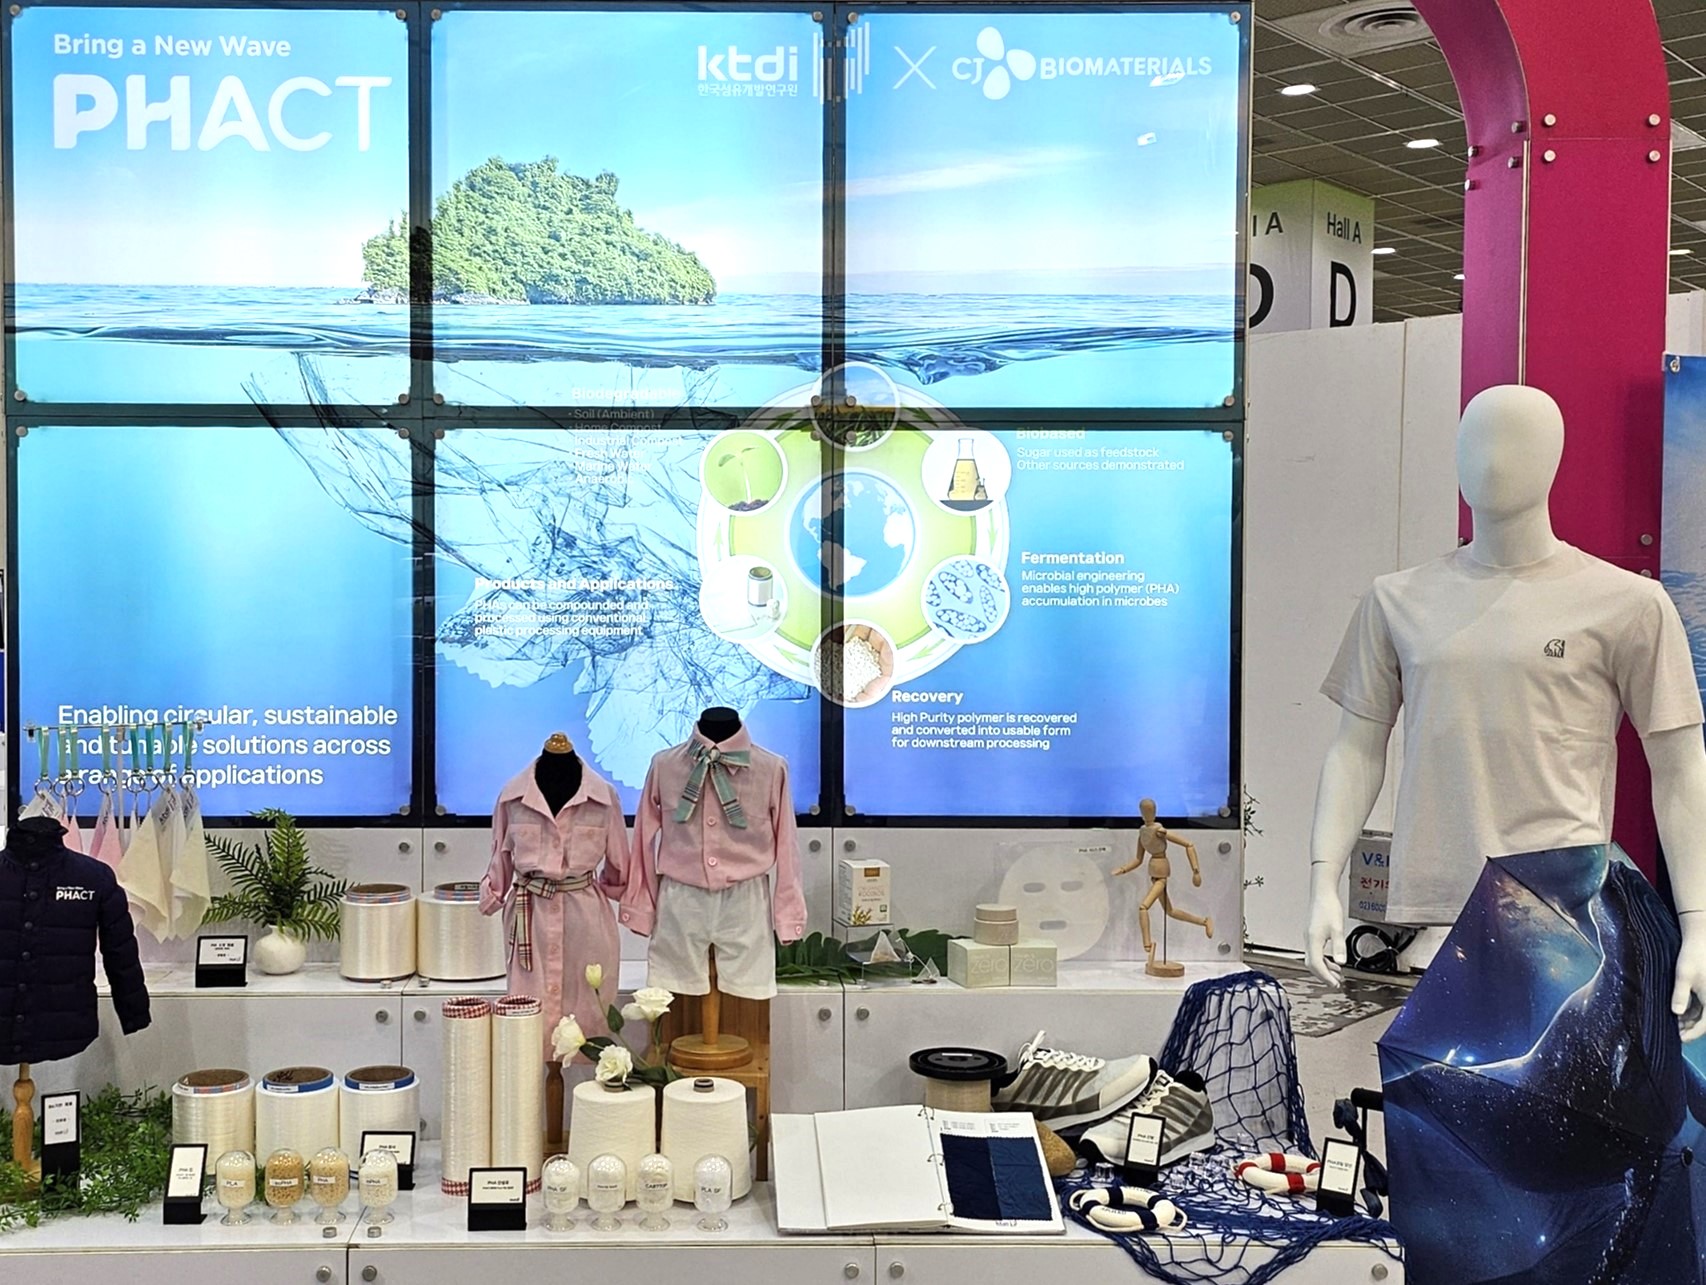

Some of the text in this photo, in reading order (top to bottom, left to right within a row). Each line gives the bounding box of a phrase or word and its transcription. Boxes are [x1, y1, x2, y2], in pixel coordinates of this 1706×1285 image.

[54, 33, 291, 58] Bring a New Wave
[698, 45, 798, 82] ktdi
[951, 56, 1213, 85] CJ BIOMATERIALS
[53, 73, 392, 152] PHACT
[1265, 211, 1284, 236] A
[1327, 212, 1362, 244] Hall A
[1330, 261, 1357, 328] D
[574, 409, 655, 420] Soil (Ambient)
[1016, 427, 1086, 440] Biobased
[1016, 447, 1160, 459] Sugar used as feedstock
[1016, 460, 1185, 471] Other sources demonstrated
[1021, 551, 1125, 565] Fermentation
[1021, 570, 1146, 583] Microbial engineering
[475, 577, 675, 593] Products and Applications
[1021, 583, 1180, 595] enables high polymer (PHA)
[475, 600, 649, 612] PHAs can be compounded and
[1021, 596, 1168, 607] accumulation in microbes
[475, 613, 646, 625] processed using conventional
[475, 625, 643, 638] plastic processing equipment
[891, 690, 964, 705] Recovery
[59, 705, 399, 729] Enabling circular, sustainable
[891, 712, 1078, 725] High Purity polymer is recovered
[891, 725, 1071, 736] and converted into usable form
[203, 734, 308, 756] solutions
[313, 739, 392, 756] across
[891, 737, 1050, 751] for downstream processing
[180, 764, 324, 788] applications
[56, 890, 95, 900] PHACT
